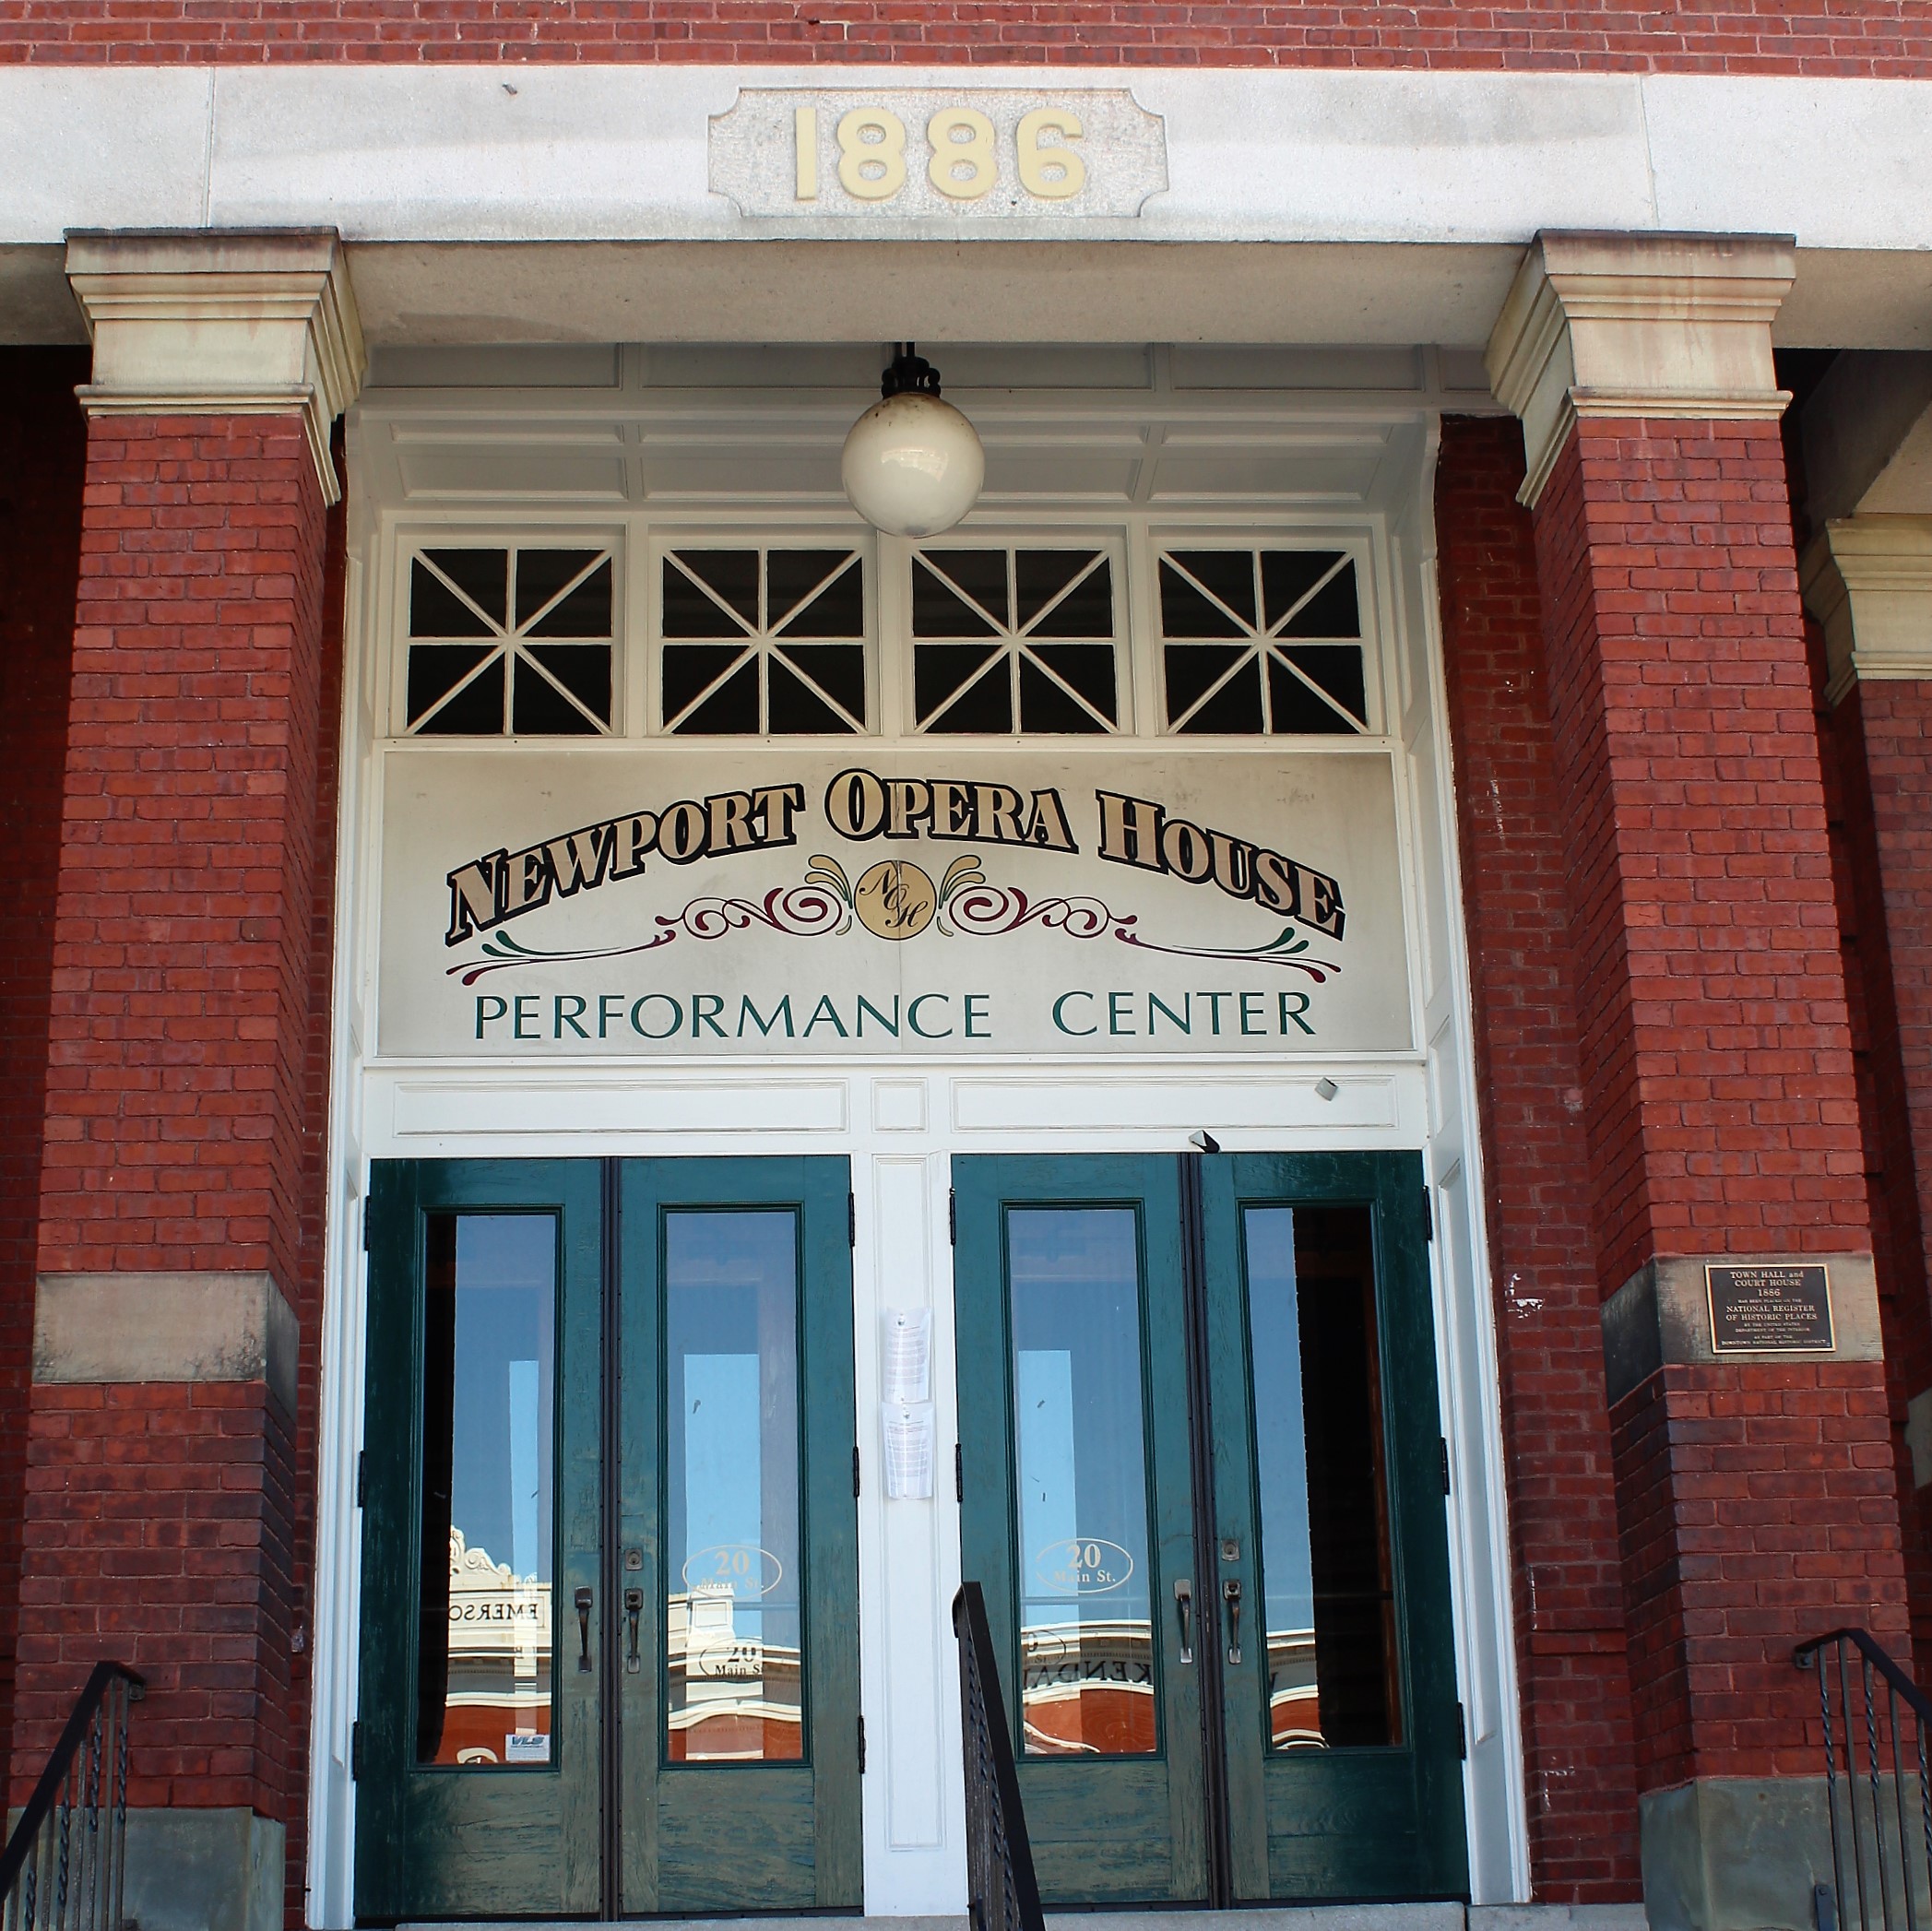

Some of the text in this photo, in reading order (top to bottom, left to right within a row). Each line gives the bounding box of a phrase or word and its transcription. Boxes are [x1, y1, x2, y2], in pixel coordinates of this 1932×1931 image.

[795, 106, 1086, 201] 1886
[444, 766, 1346, 947] NEWPORT OPERA HOUSE
[474, 990, 1318, 1039] PERFORMANCE CENTER
[1730, 1271, 1758, 1279] TOWN
[1760, 1271, 1786, 1279] HALL
[1734, 1279, 1801, 1287] COURT HOUSE
[1758, 1288, 1781, 1297] 1886
[1725, 1305, 1770, 1313] NATIONAL
[1784, 1312, 1818, 1321] PLACES
[714, 1549, 751, 1576] 20
[1067, 1543, 1101, 1570] 20
[1096, 1570, 1116, 1583] St.
